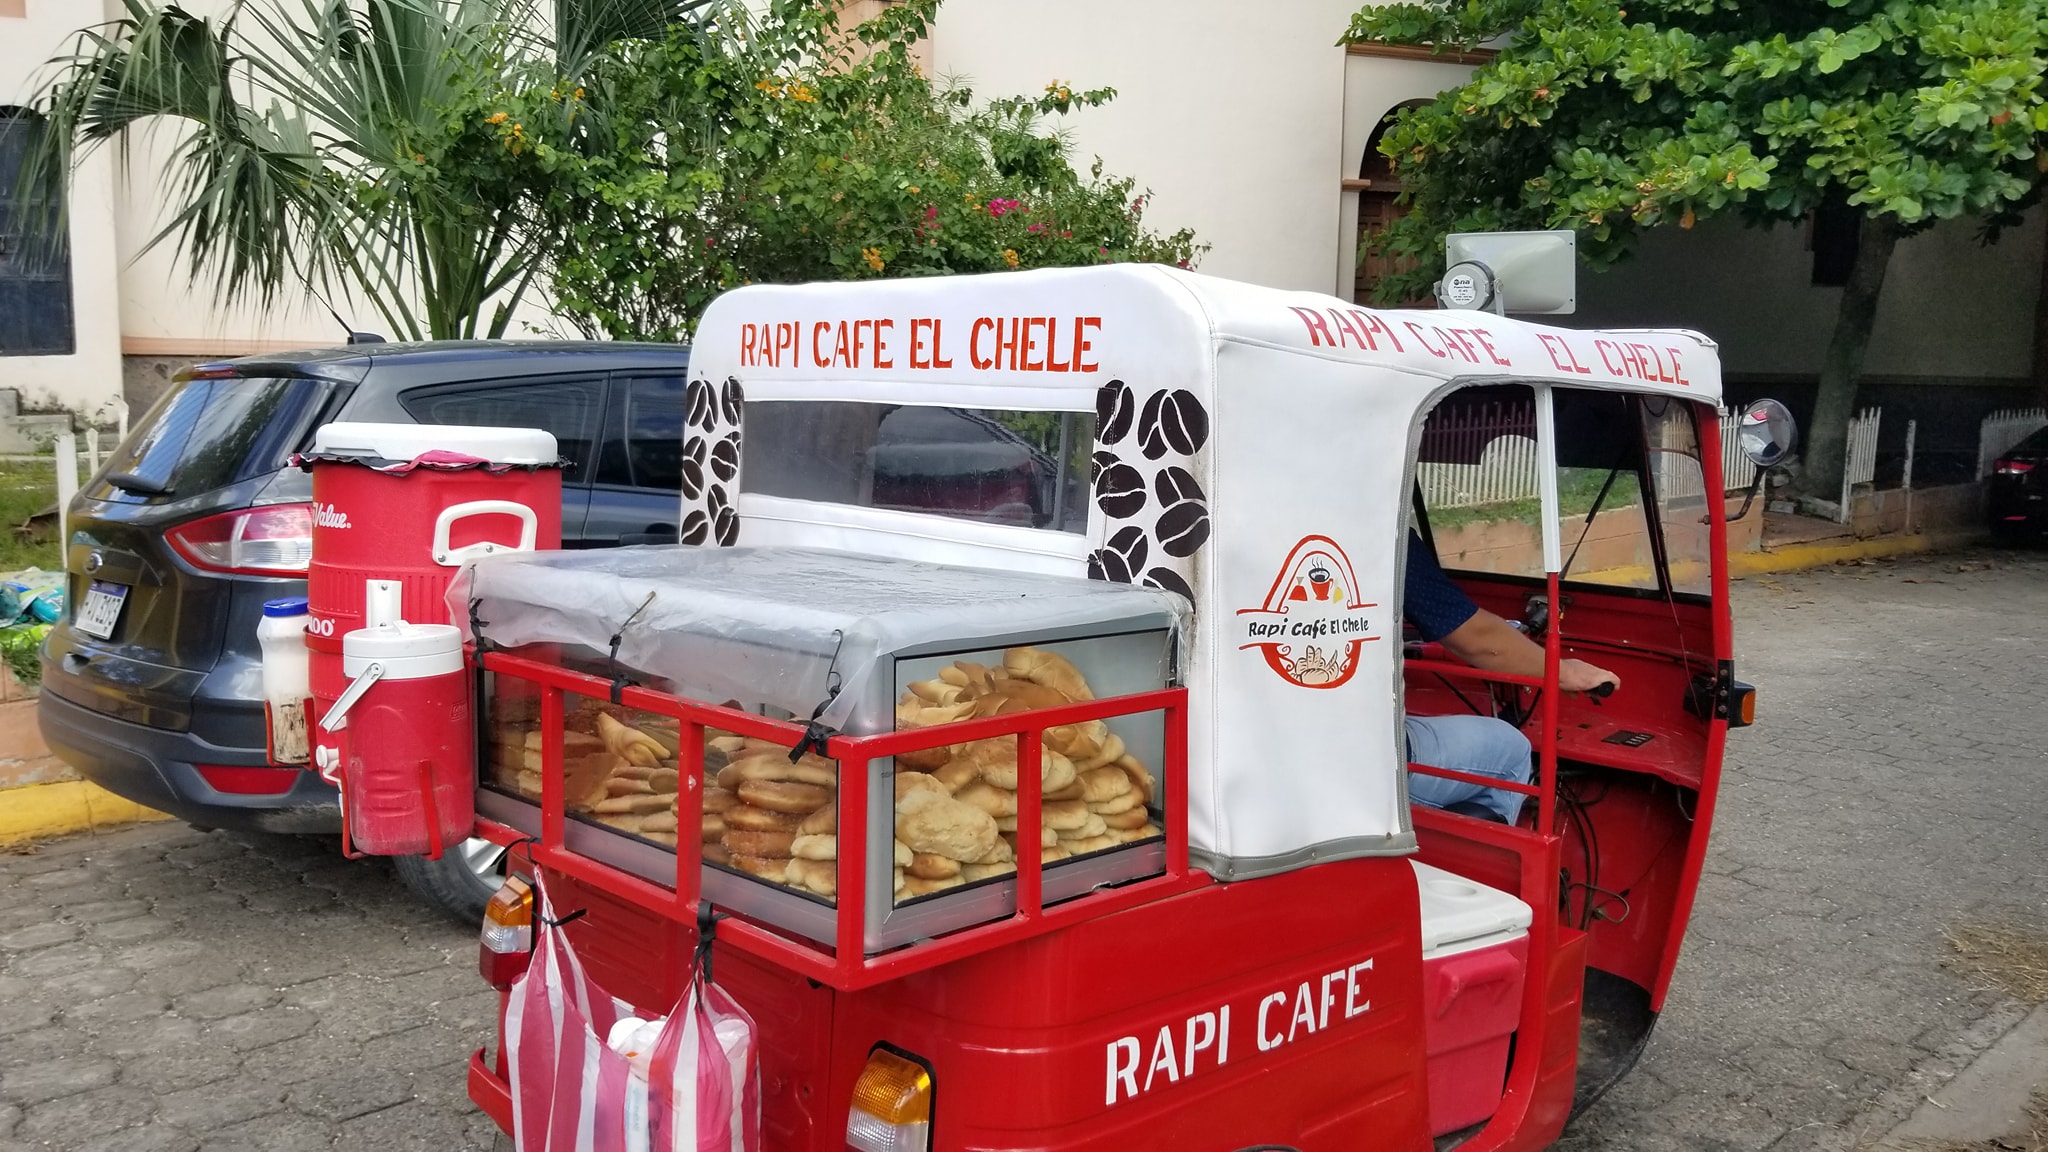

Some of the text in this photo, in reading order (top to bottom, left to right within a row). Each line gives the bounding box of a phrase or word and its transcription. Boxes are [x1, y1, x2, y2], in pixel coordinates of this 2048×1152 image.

[741, 316, 1102, 373] RAPI CAFE EL CHELE
[1290, 306, 1690, 386] RAPI CAFE EL CHELE
[1249, 616, 1369, 639] Rapi Café El Chele
[1105, 957, 1374, 1106] RAPI CAFE
